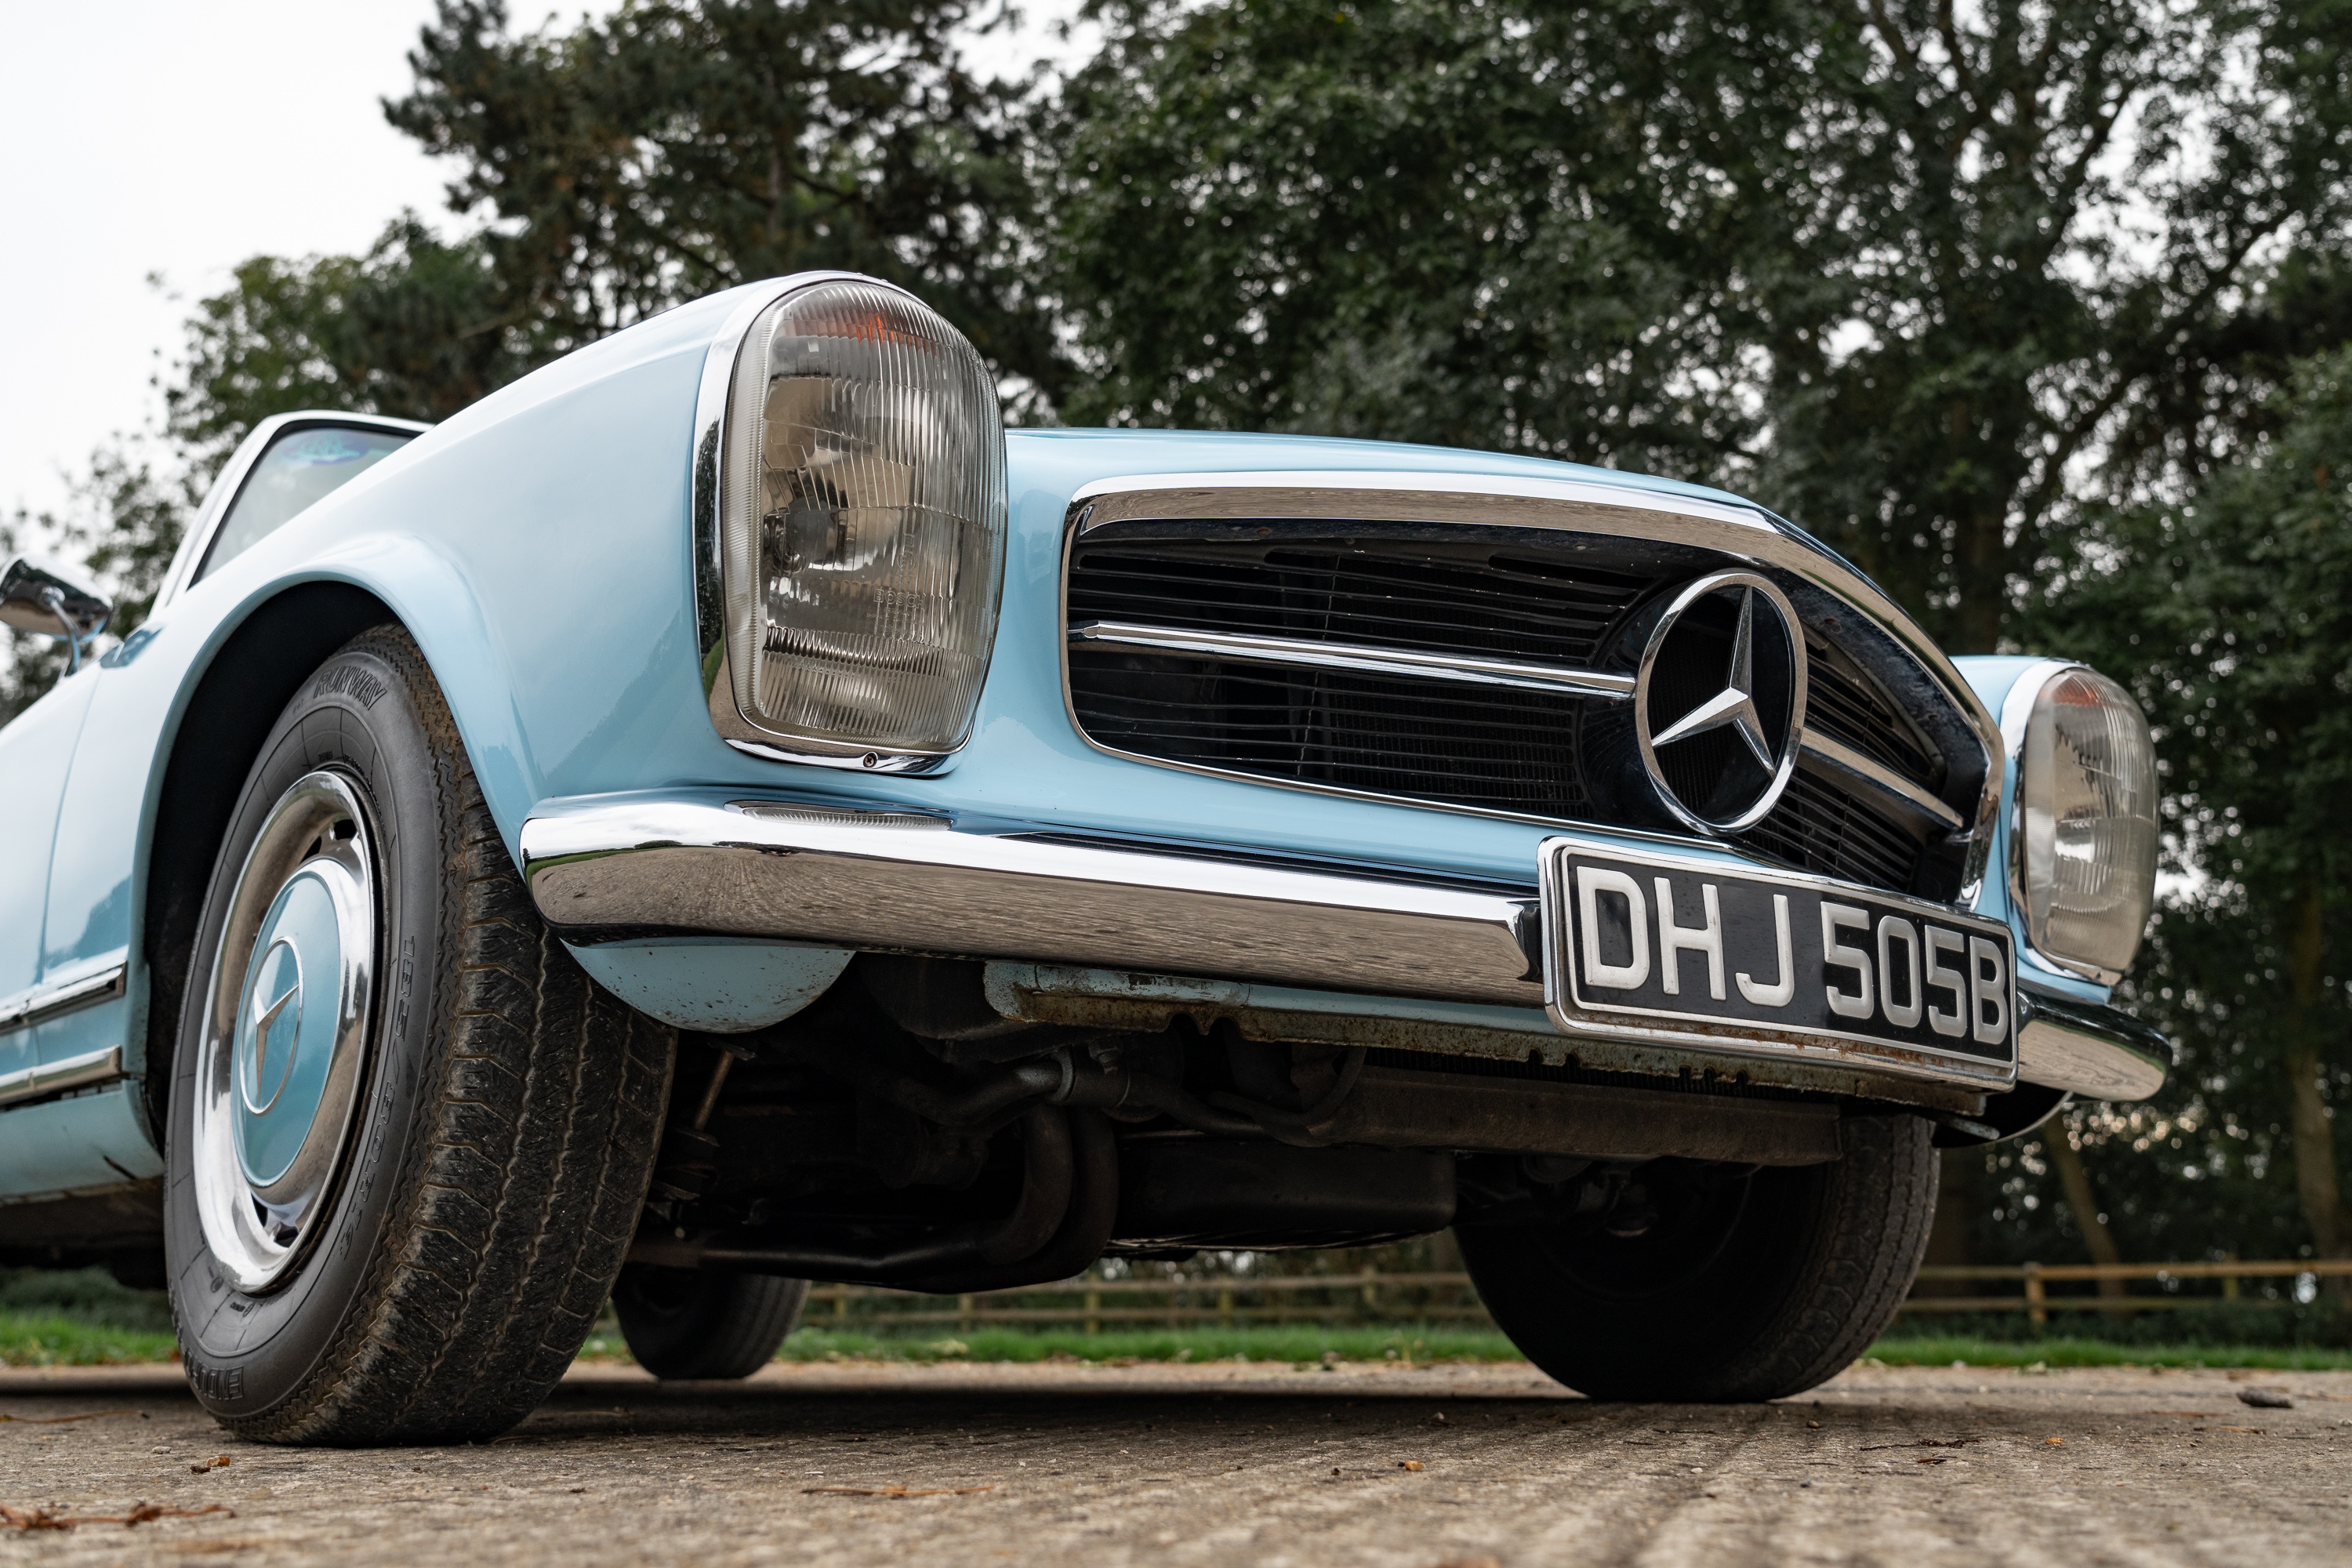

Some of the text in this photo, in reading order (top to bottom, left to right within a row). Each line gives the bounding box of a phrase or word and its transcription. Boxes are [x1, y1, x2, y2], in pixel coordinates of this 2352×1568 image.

[873, 587, 927, 609] BOSCH
[314, 666, 387, 711] RUNWAY
[1577, 866, 2009, 1045] DHJ 505B
